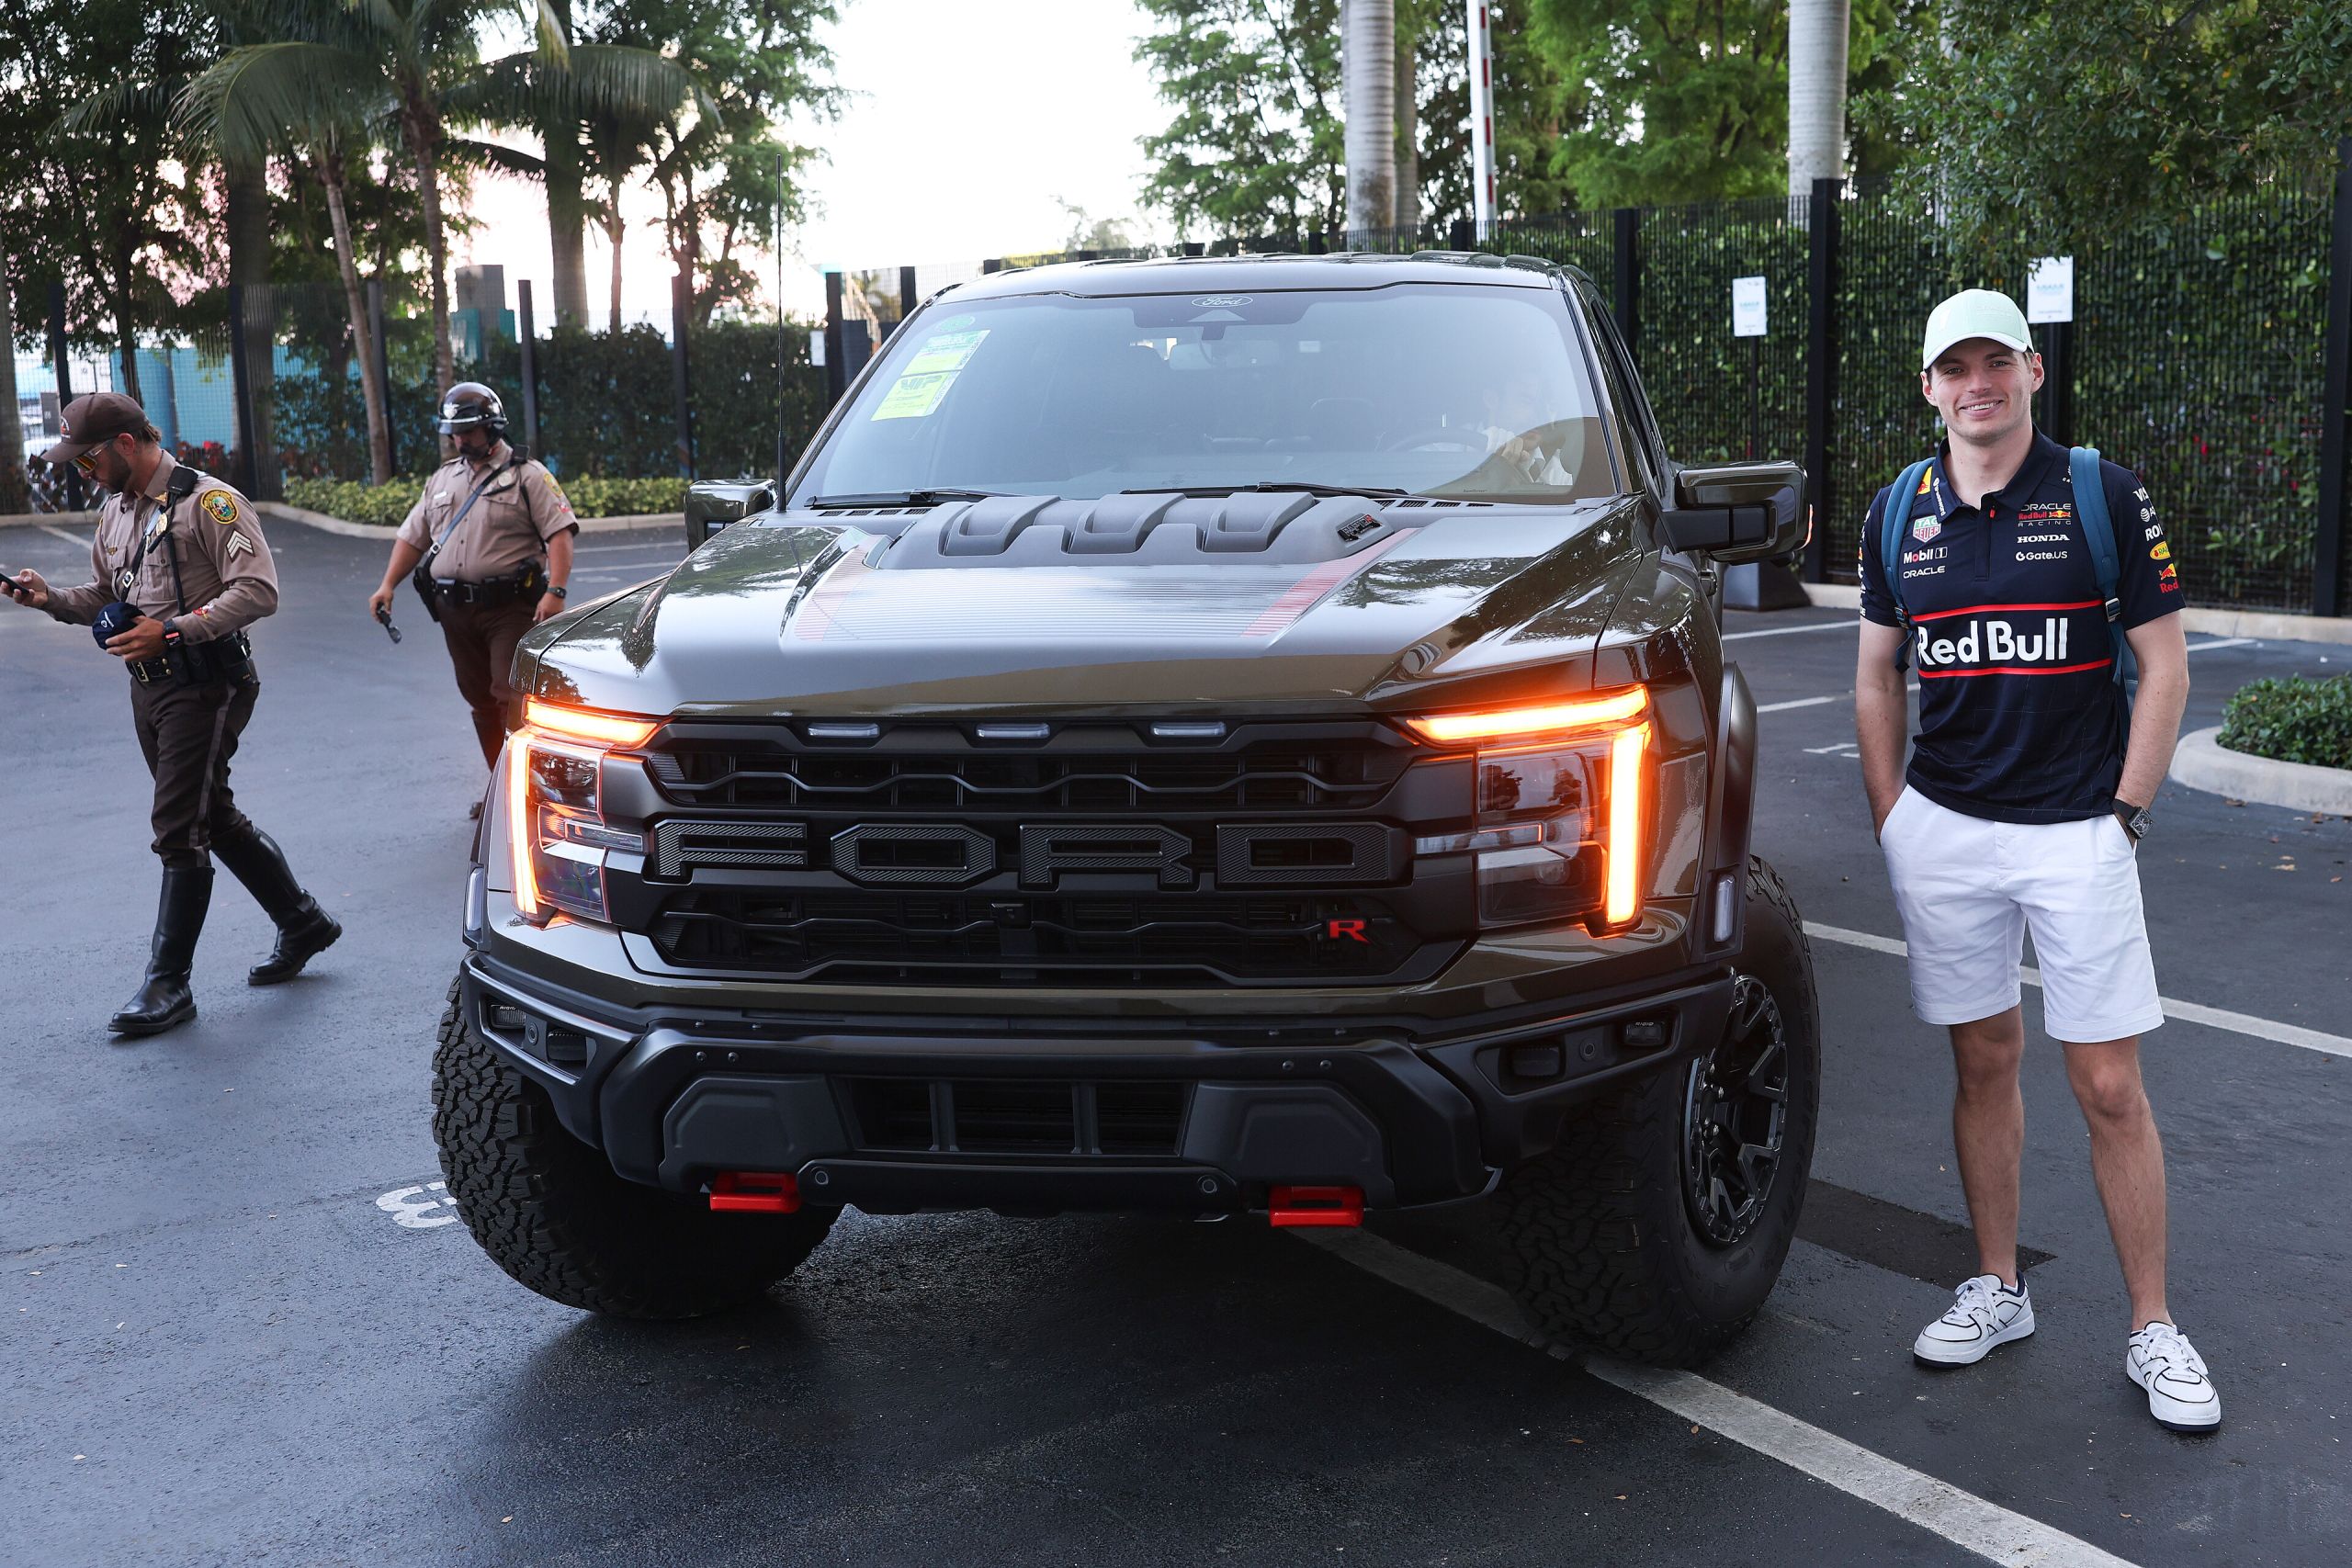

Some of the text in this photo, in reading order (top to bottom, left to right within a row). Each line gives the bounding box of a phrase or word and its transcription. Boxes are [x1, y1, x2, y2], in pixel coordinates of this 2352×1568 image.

[1202, 297, 1243, 306] Ford
[900, 375, 943, 390] VIP
[2020, 502, 2072, 512] ORACLE
[1917, 517, 1938, 528] TAG
[2018, 511, 2047, 520] Red Bull
[1914, 526, 1939, 540] HEUER
[2017, 534, 2071, 544] HONDA
[1904, 548, 1934, 564] Mobil
[2026, 550, 2068, 561] Gate.US
[1903, 565, 1946, 580] ORACLE
[2159, 578, 2179, 594] Red
[1917, 617, 2068, 666] Red Bull
[653, 819, 1391, 889] FORD
[1329, 919, 1371, 945] R
